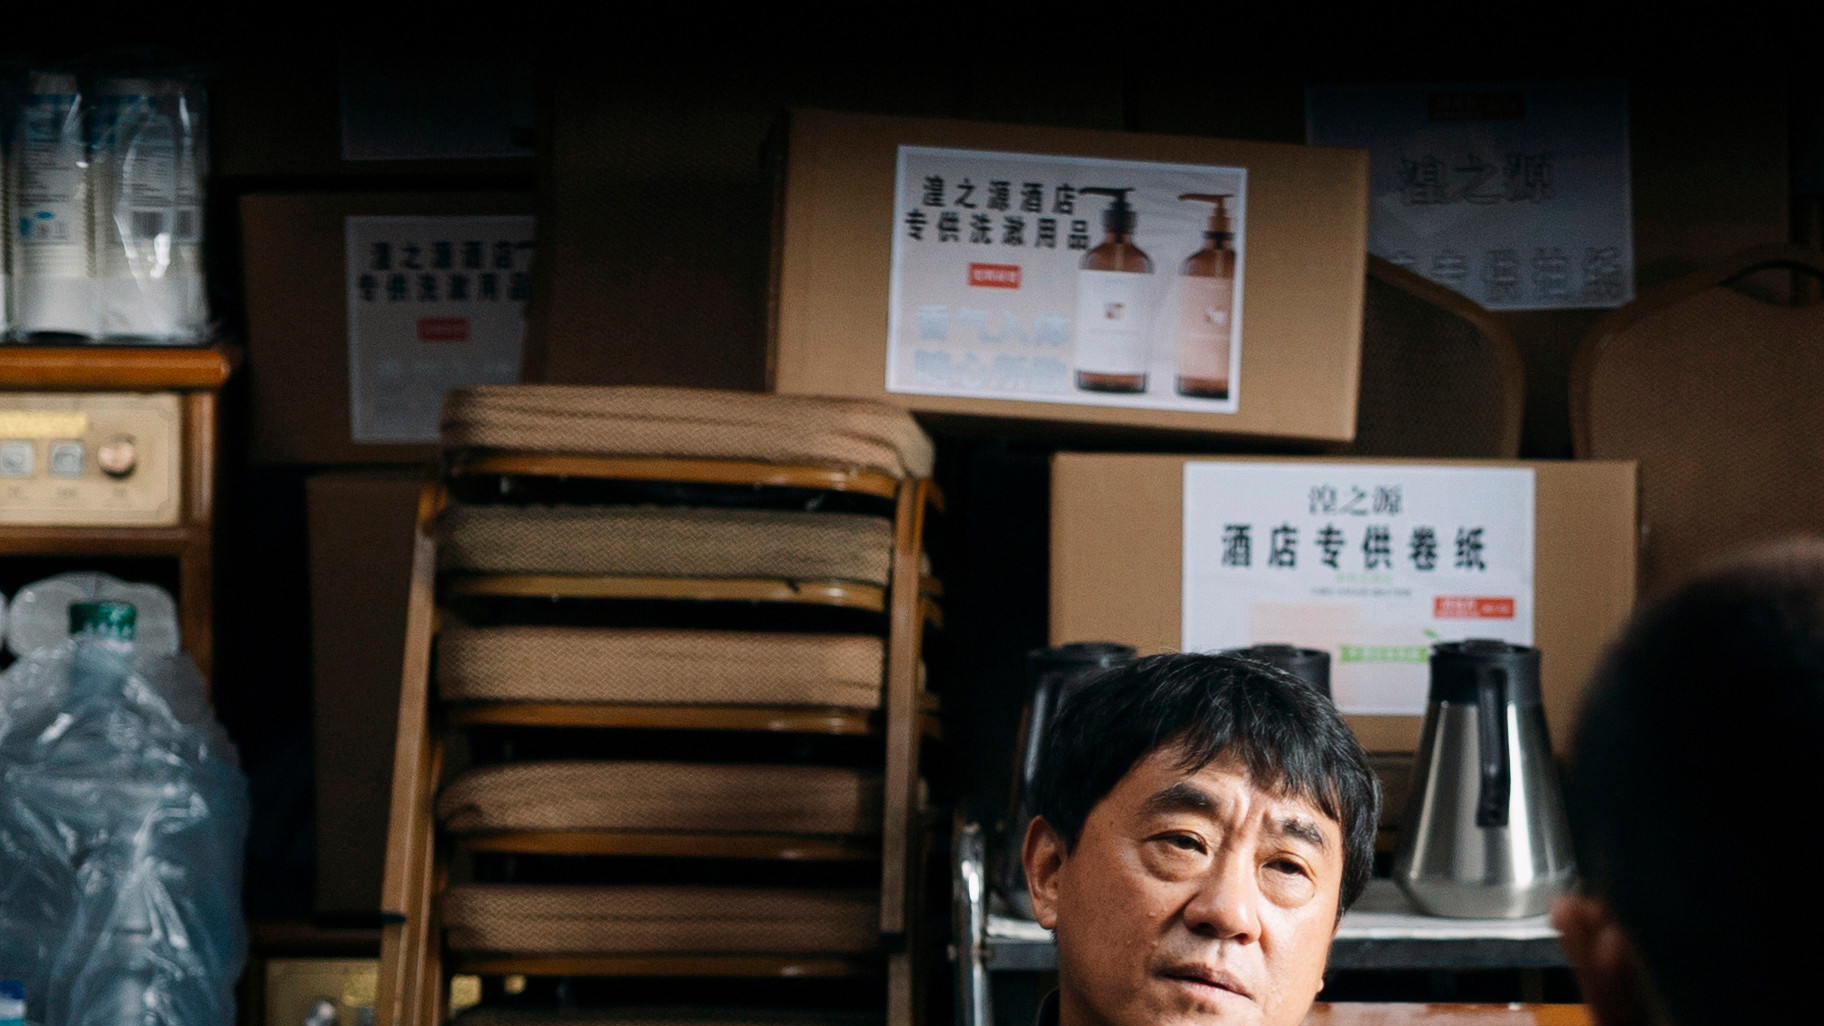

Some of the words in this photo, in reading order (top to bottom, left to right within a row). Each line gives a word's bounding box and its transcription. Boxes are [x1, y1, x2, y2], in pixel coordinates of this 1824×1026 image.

[1221, 522, 1487, 571] 酒店专供卷纸
